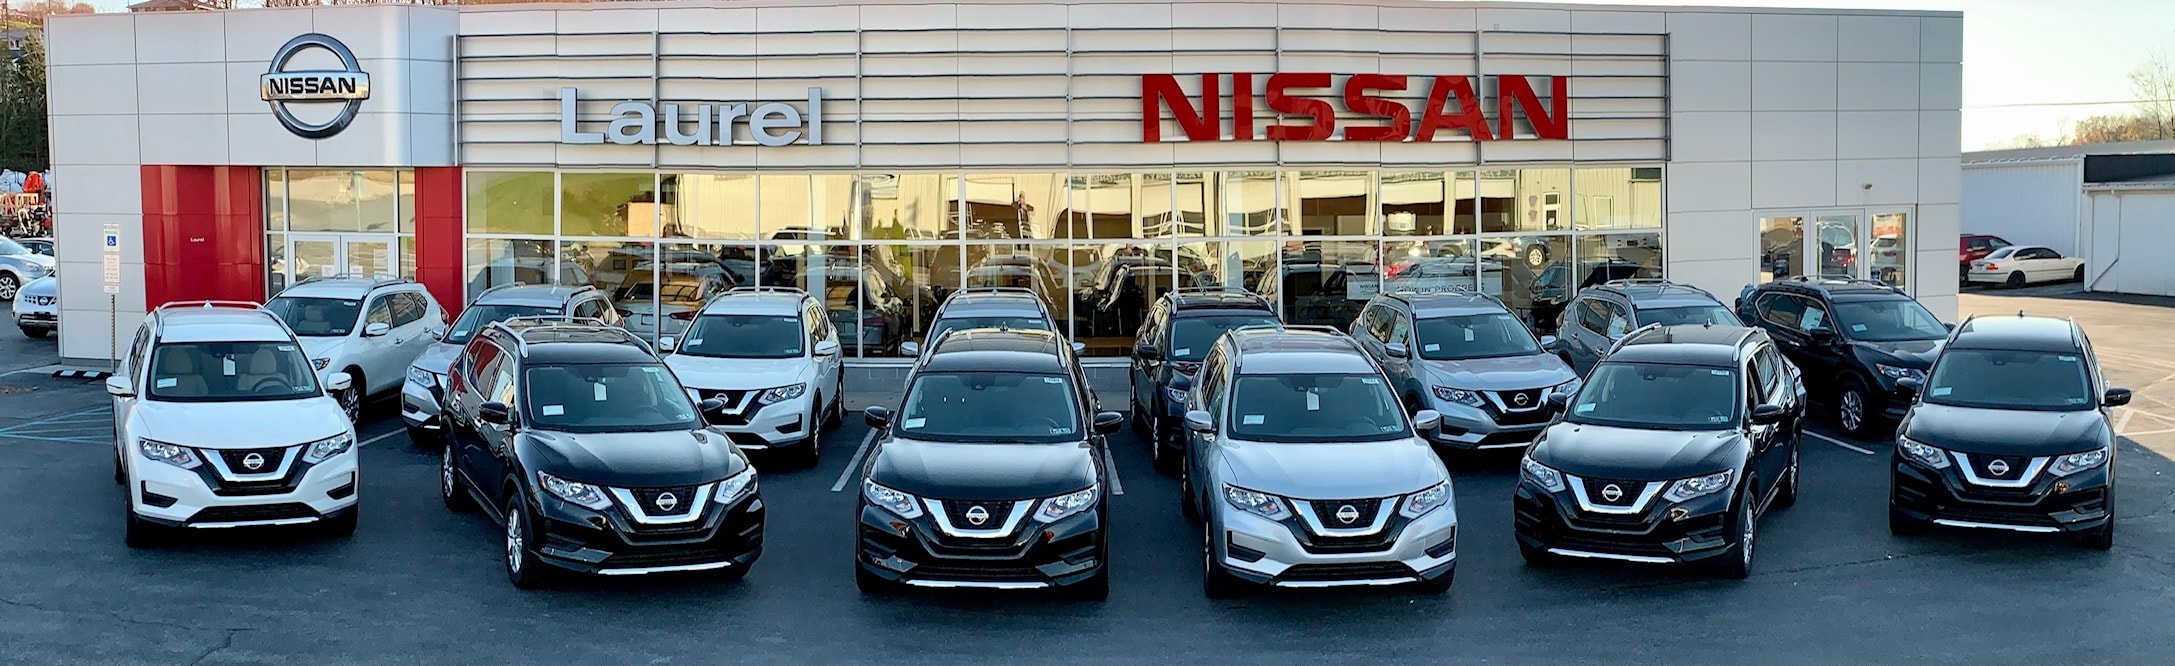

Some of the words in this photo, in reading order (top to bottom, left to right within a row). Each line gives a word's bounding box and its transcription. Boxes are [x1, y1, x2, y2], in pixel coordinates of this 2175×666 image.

[269, 77, 356, 94] NISSAN
[561, 87, 823, 147] Laurel
[1142, 72, 1569, 143] NISSAN
[1434, 283, 1485, 292] PROGRES
